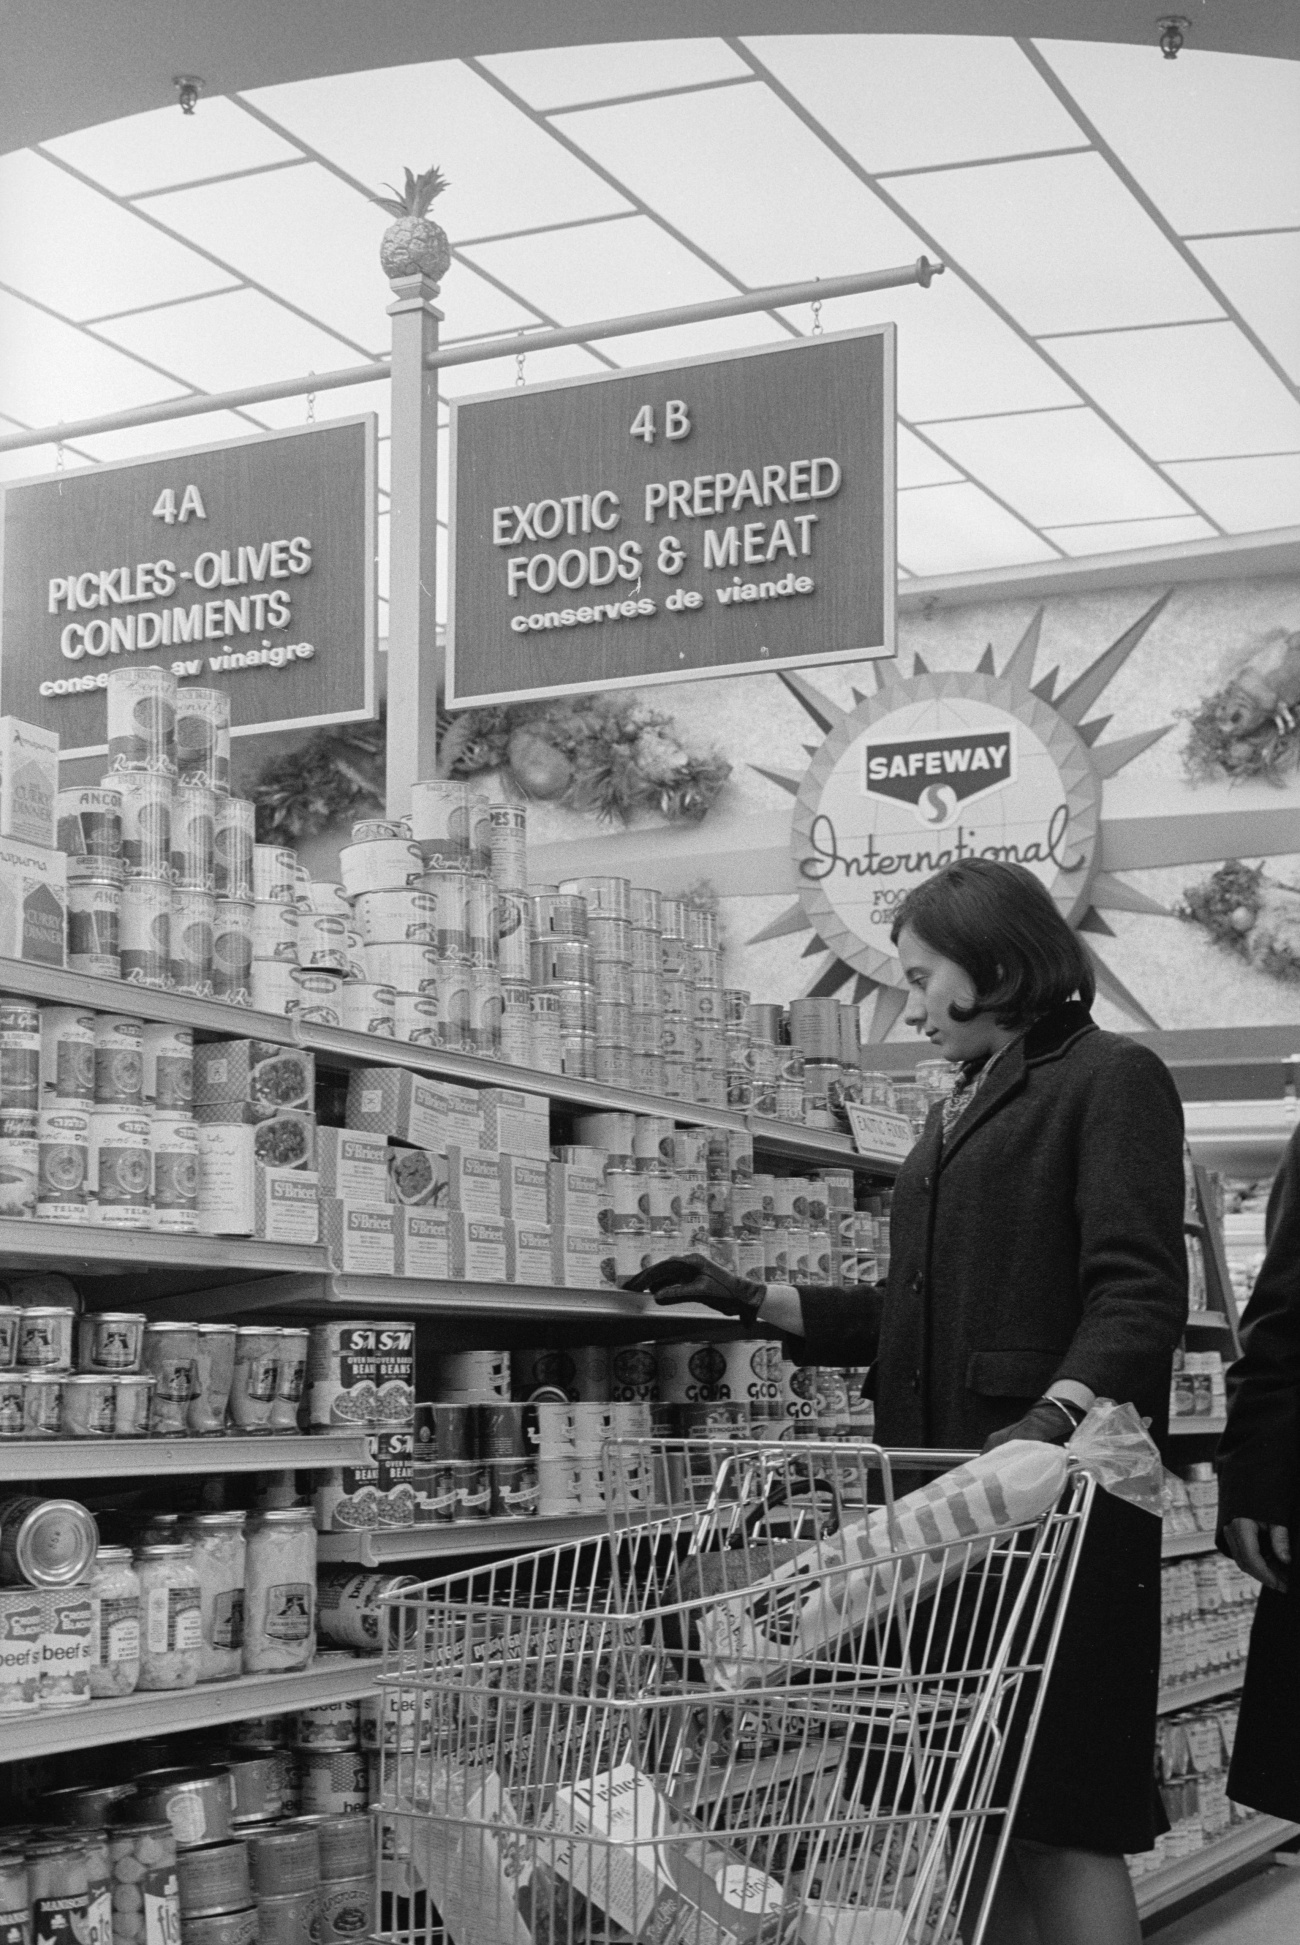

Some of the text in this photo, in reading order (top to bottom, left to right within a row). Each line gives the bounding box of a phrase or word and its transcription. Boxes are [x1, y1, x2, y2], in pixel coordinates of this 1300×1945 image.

[629, 400, 691, 443] 4 B
[152, 484, 207, 525] 4A
[492, 456, 842, 546] EXOTIC PREPARED
[507, 513, 819, 597] FOODS & MEAT
[60, 589, 292, 661] CONDIMENTS
[510, 572, 815, 633] conserves de viande
[39, 671, 109, 697] conse
[208, 639, 315, 673] vinaigre
[868, 744, 1008, 781] SAFEWAY
[799, 803, 1086, 882] International
[872, 887, 911, 906] FOO
[380, 1363, 411, 1375] BEANS
[42, 1642, 81, 1661] beef
